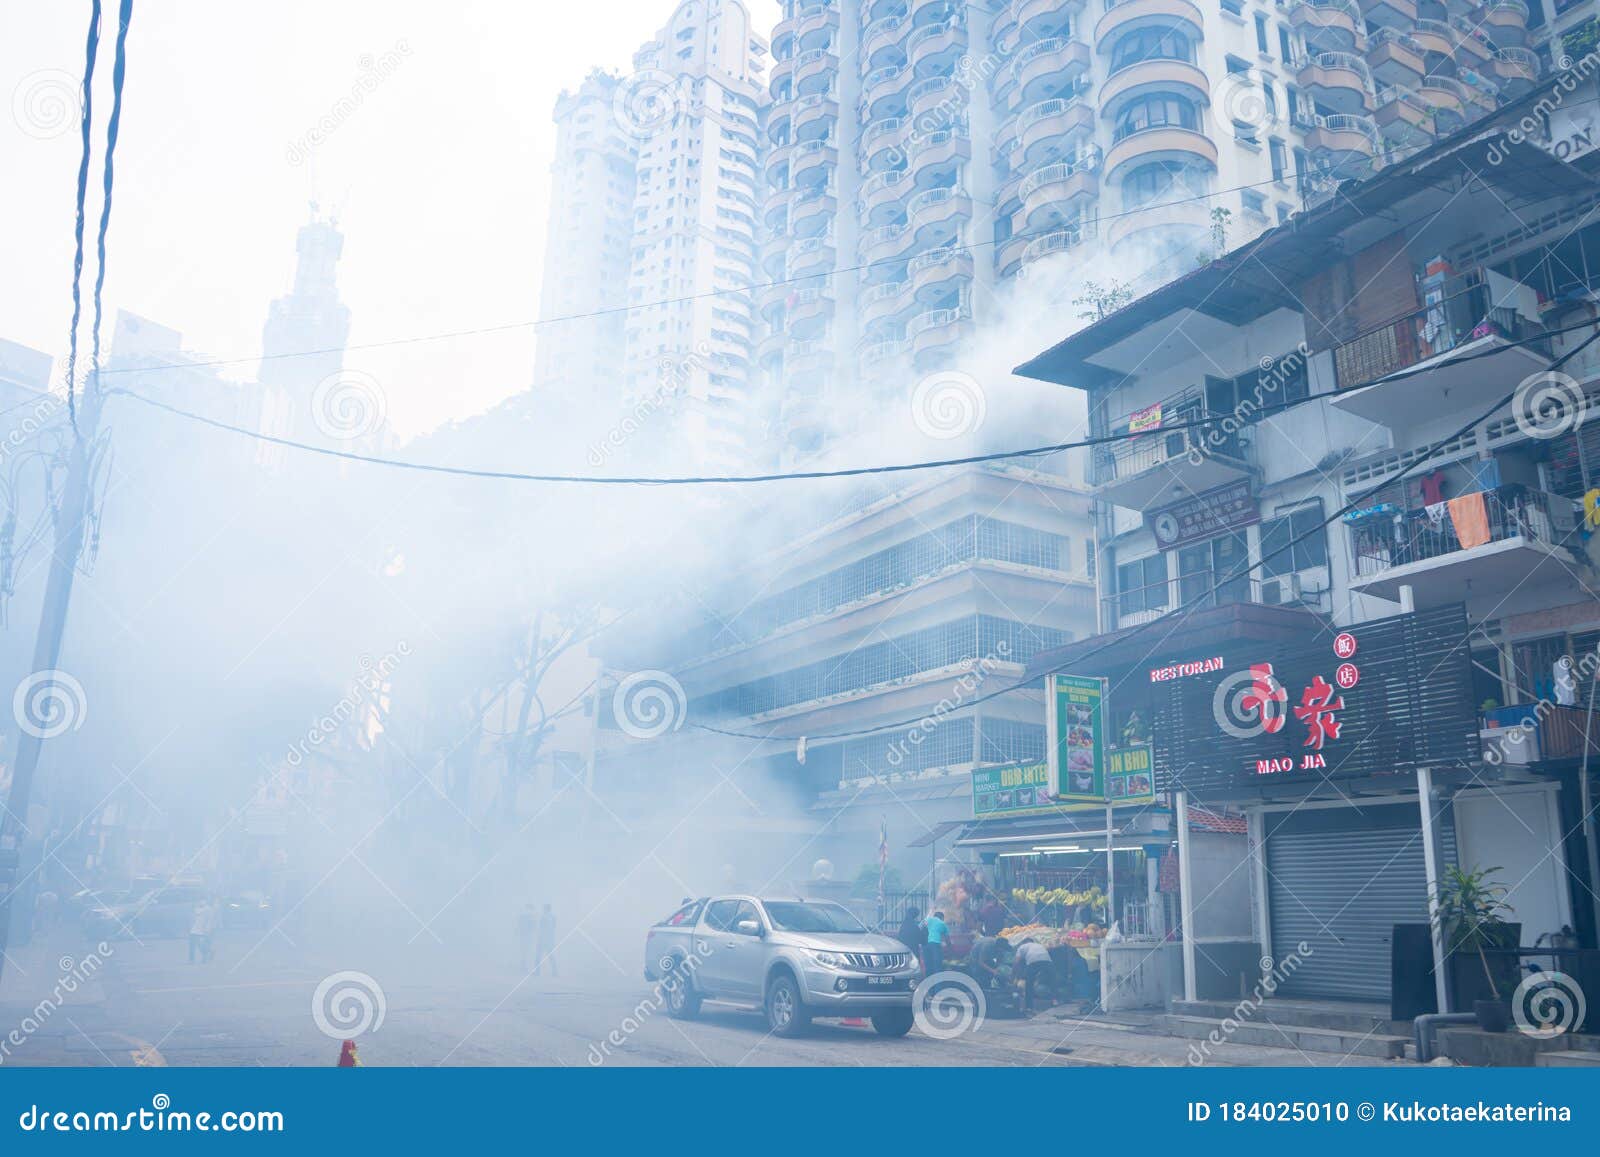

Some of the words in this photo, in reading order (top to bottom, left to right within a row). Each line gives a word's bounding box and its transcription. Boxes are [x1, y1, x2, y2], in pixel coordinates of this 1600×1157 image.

[1151, 656, 1224, 683] RESTORAN
[1256, 757, 1293, 774] MAO
[1299, 753, 1326, 770] JIA
